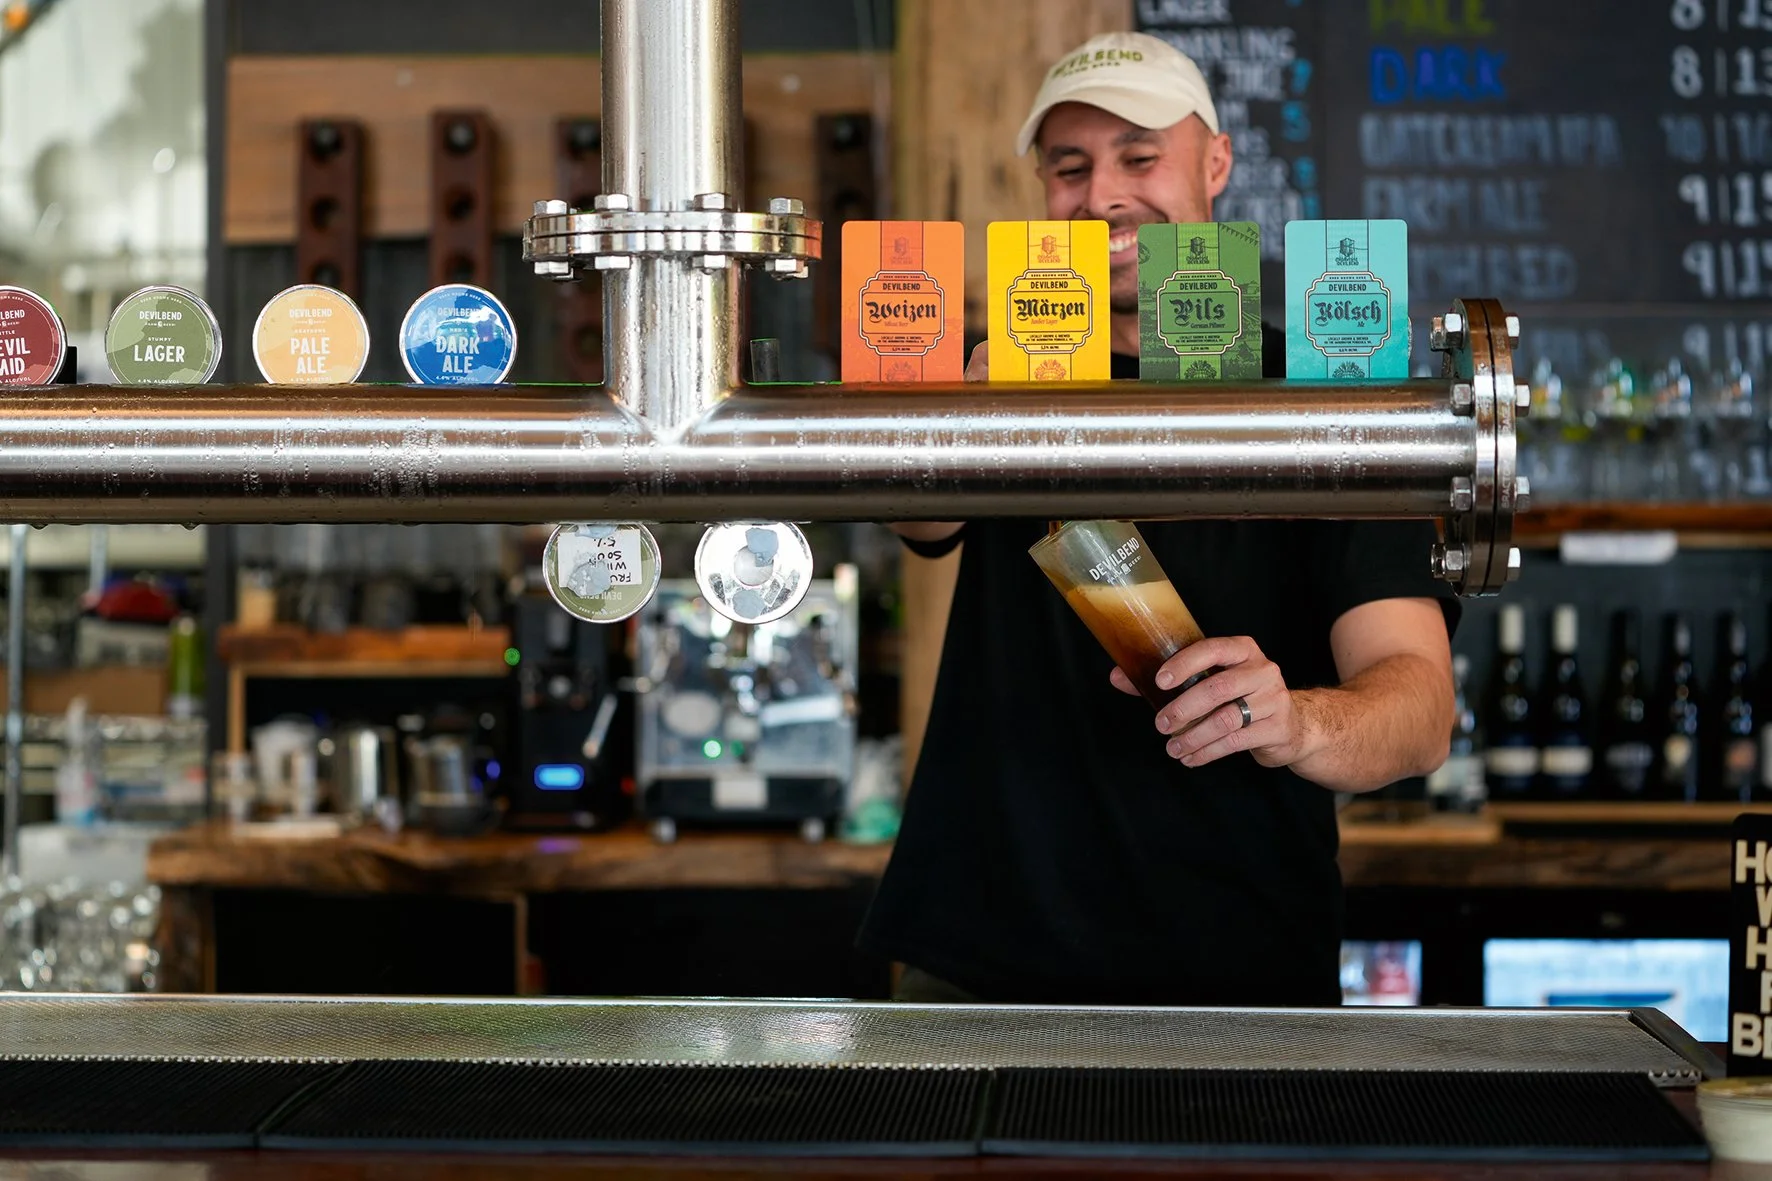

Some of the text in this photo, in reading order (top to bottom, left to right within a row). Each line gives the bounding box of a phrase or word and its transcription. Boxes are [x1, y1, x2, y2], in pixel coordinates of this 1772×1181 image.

[1369, 44, 1508, 103] DARK
[1671, 44, 1704, 98] 8
[1678, 173, 1710, 224] 9
[1682, 240, 1716, 297] 9
[882, 282, 920, 290] DEVILBEND
[1030, 281, 1068, 289] DEVILBEND
[1180, 282, 1218, 290] DEVILBEND
[1328, 284, 1367, 292] DEVILBEND
[0, 309, 25, 320] LBEND
[139, 311, 182, 320] DEVILBEND
[289, 308, 332, 318] DEVILBEND
[865, 300, 937, 323] Weizen
[1014, 299, 1085, 321] Märzen
[1169, 297, 1225, 327] Pils
[1314, 300, 1382, 326] Kölsch
[134, 345, 185, 362] LAGER
[290, 337, 331, 355] PALE
[436, 335, 480, 354] DARK
[0, 357, 25, 376] AID
[296, 356, 327, 374] ALE
[442, 354, 474, 373] ALE
[1089, 537, 1140, 581] DEVILBEND
